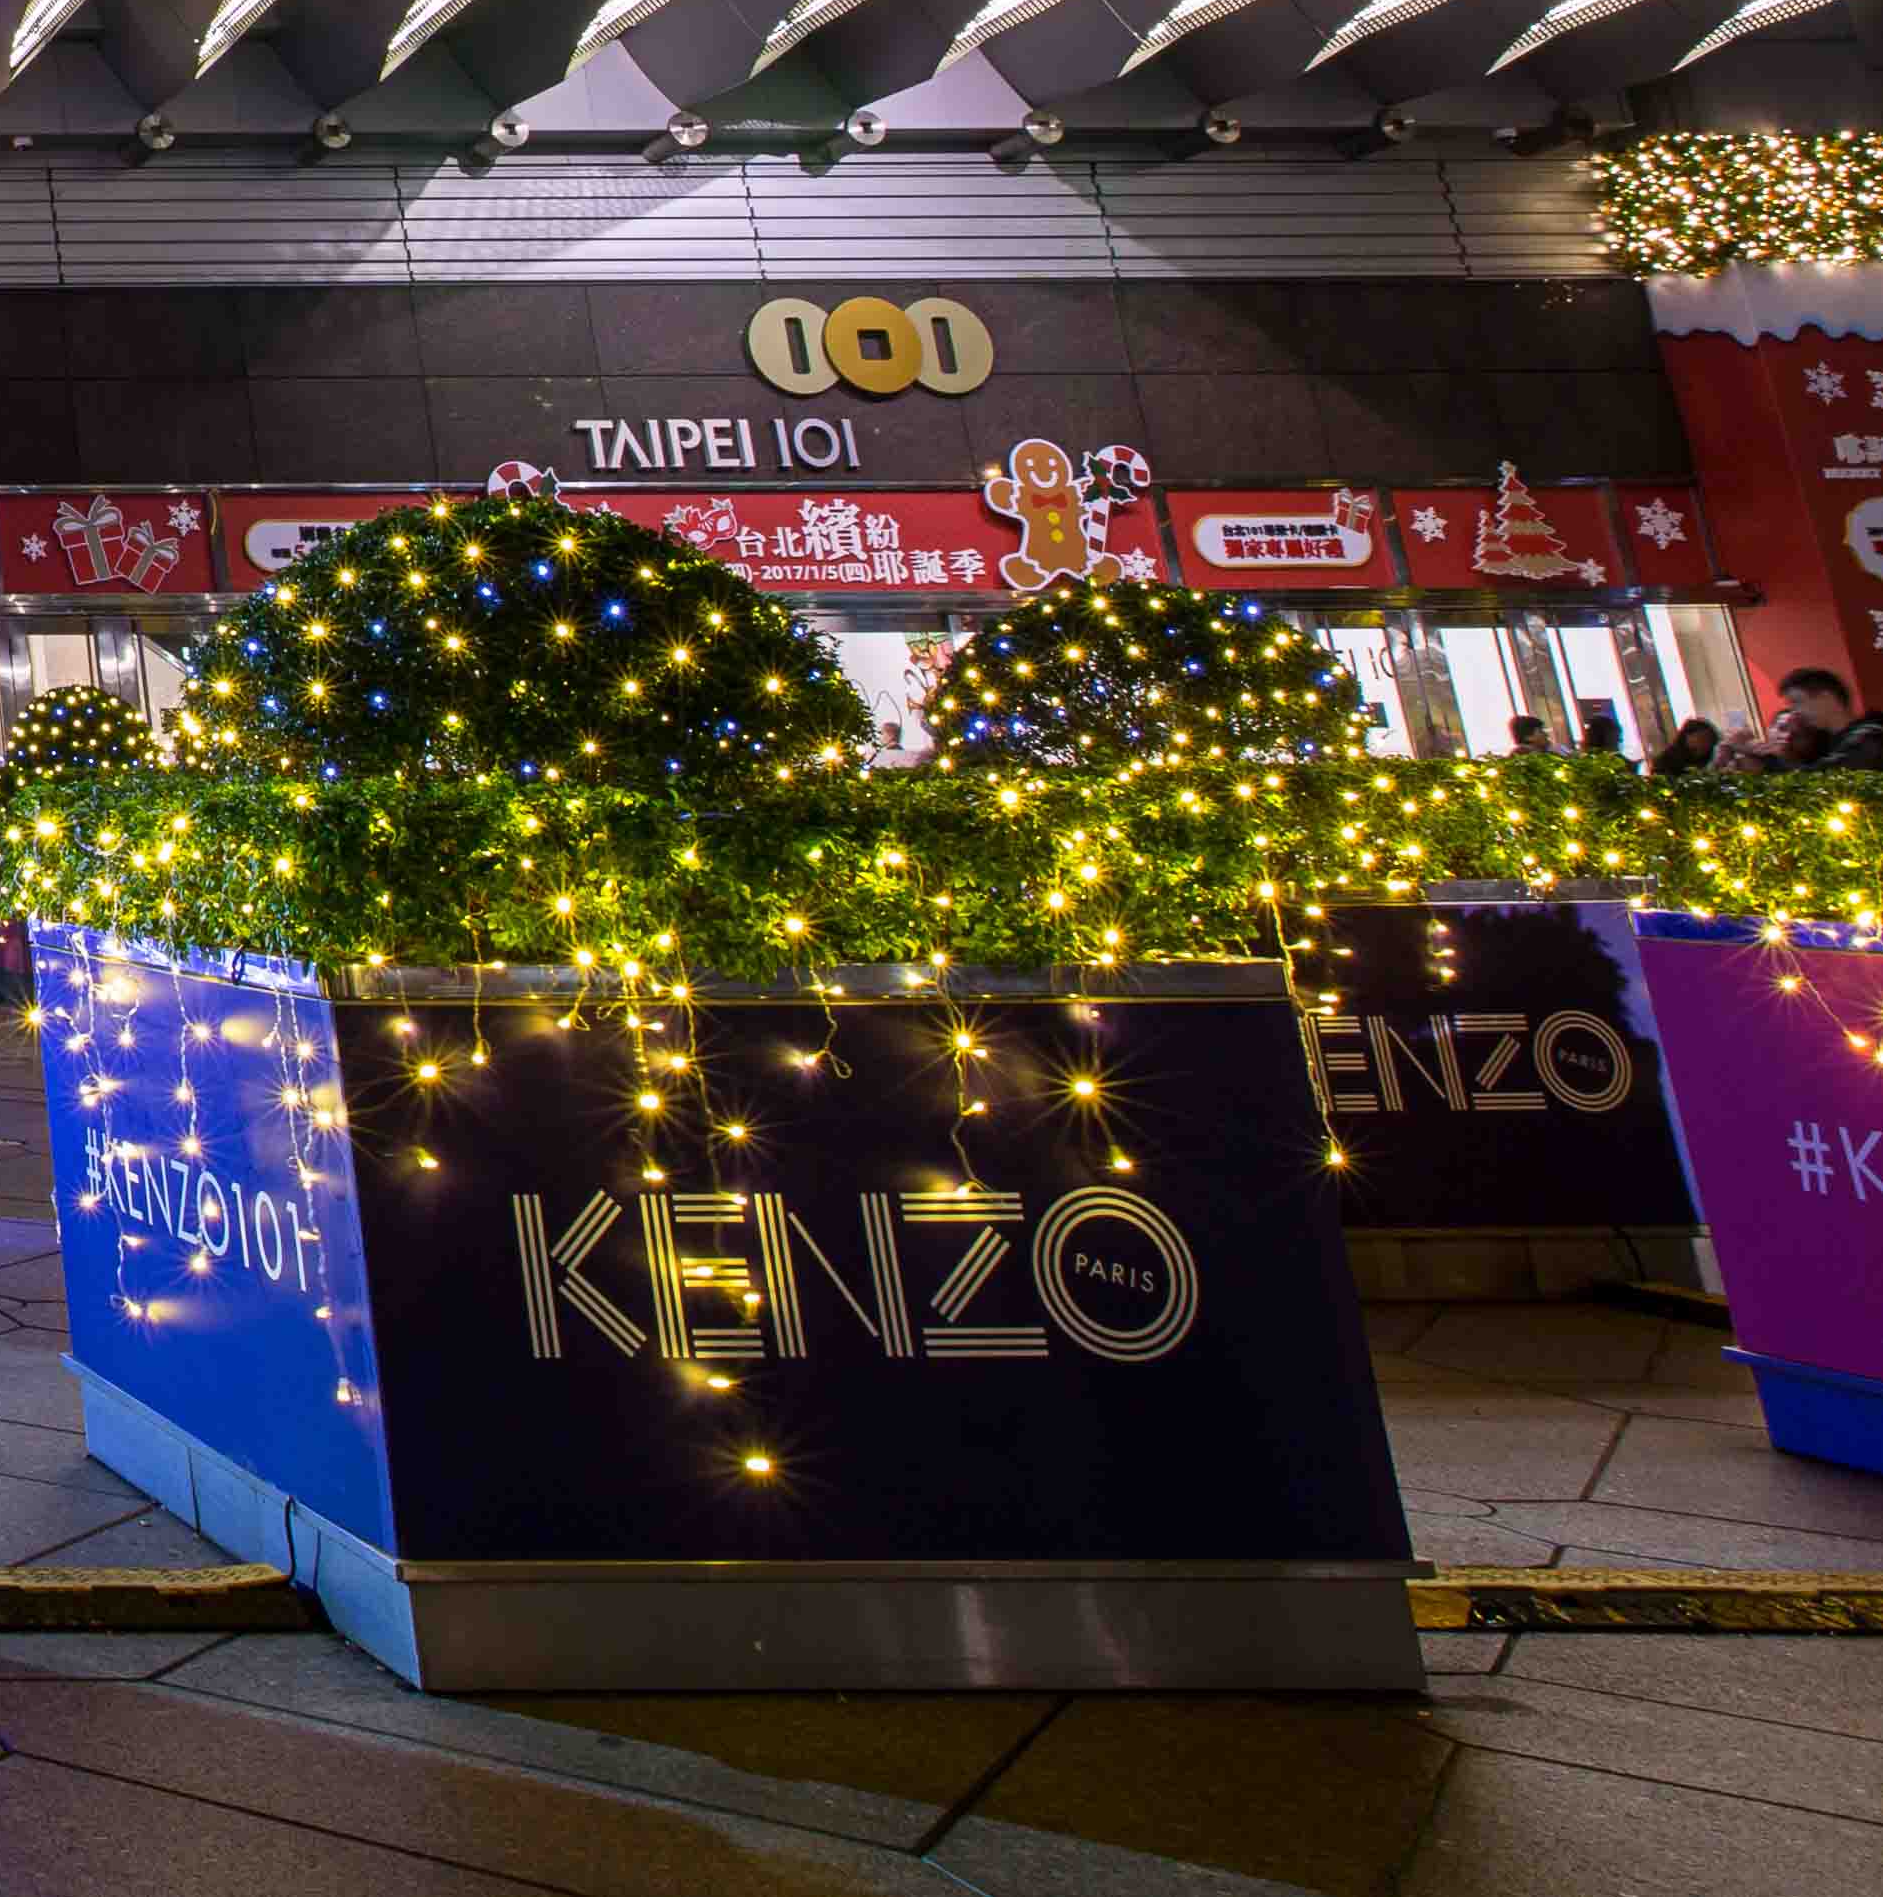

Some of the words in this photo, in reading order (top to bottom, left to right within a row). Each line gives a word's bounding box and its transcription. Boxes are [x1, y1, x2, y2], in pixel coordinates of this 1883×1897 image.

[574, 418, 757, 470] TAIPEI
[772, 417, 861, 469] 101
[1557, 1048, 1609, 1072] PARIS
[85, 1126, 307, 1292] #KENZO101
[513, 1186, 1198, 1362] KENZO
[1075, 1252, 1155, 1294] PARIS
